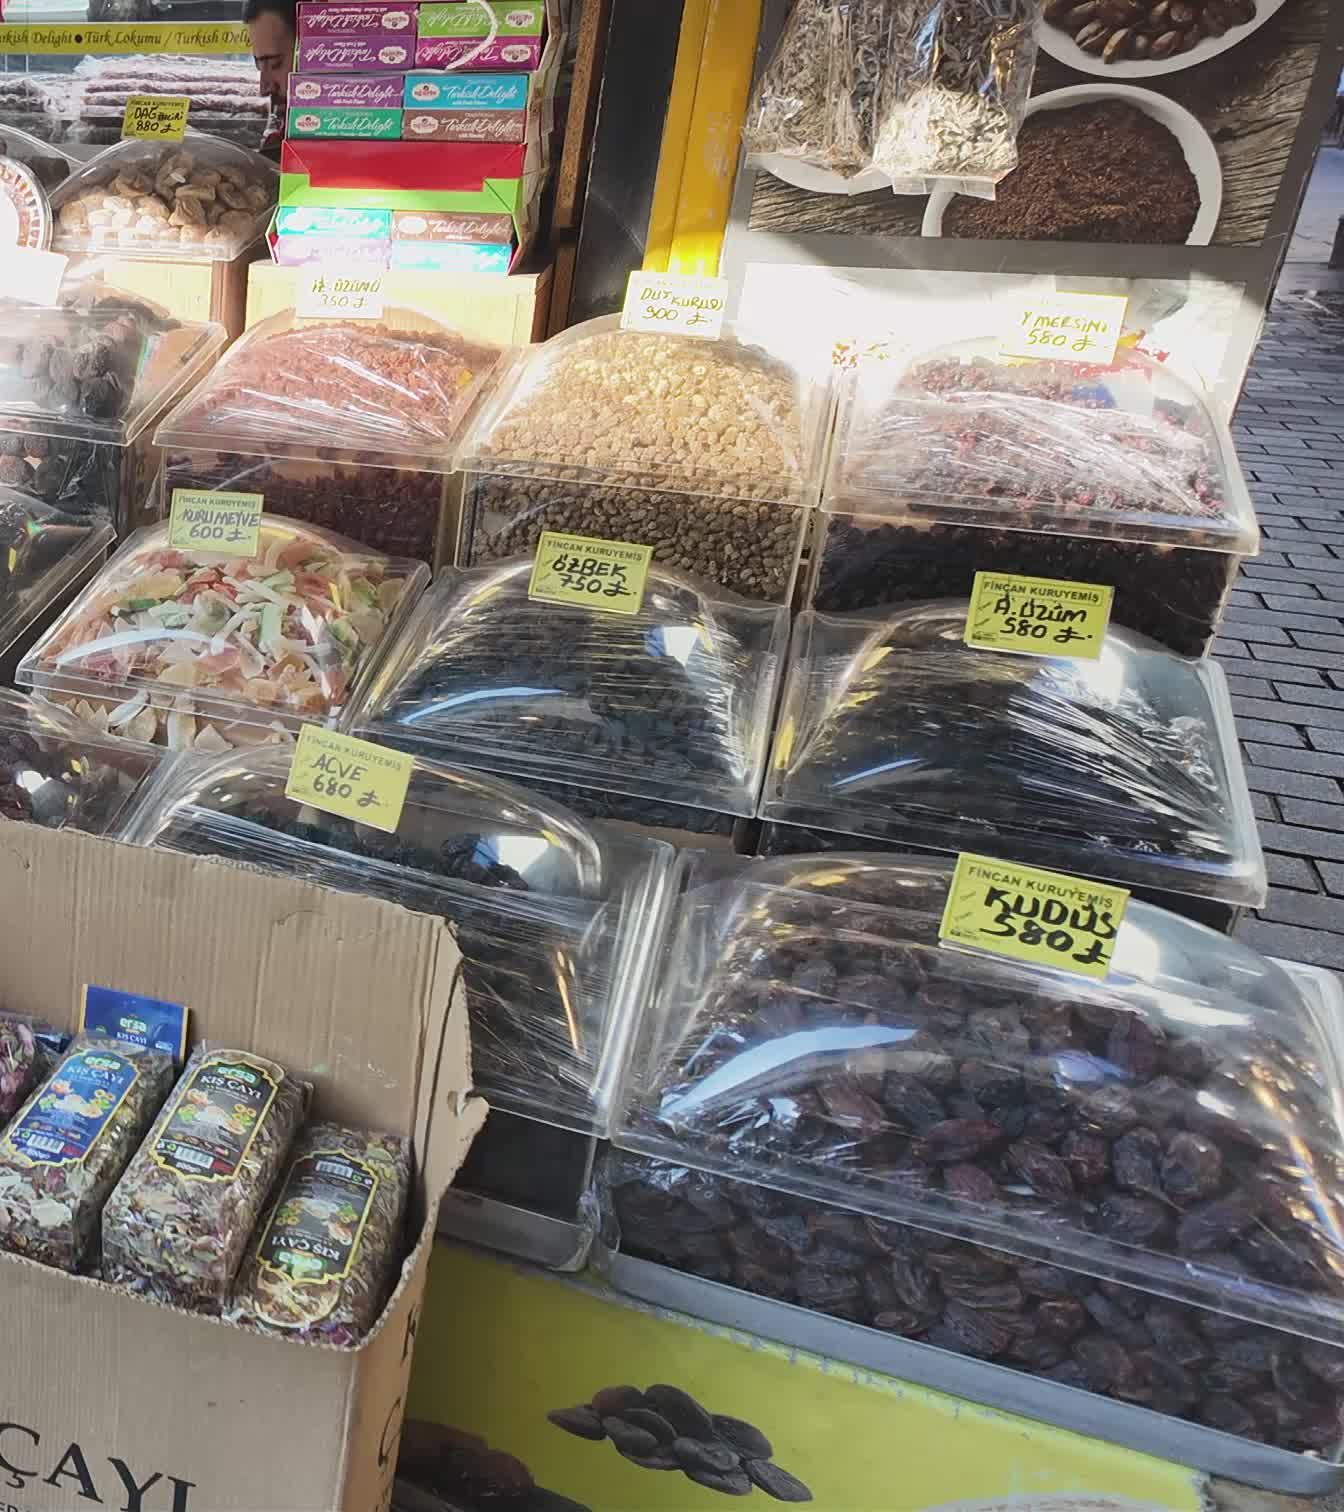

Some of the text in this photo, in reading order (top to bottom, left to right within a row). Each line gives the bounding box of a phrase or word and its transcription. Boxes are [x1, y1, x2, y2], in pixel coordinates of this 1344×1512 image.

[32, 30, 72, 48] Delight
[84, 30, 111, 46] Türk
[113, 30, 162, 46] Lokumu
[175, 30, 219, 46] Turkish
[190, 522, 224, 539] 600
[558, 573, 602, 593] 750
[1000, 616, 1048, 639] 580
[310, 753, 369, 781] ACVE
[313, 773, 353, 799] 680
[983, 886, 1118, 940] KUDÜS
[979, 911, 1075, 952] 580
